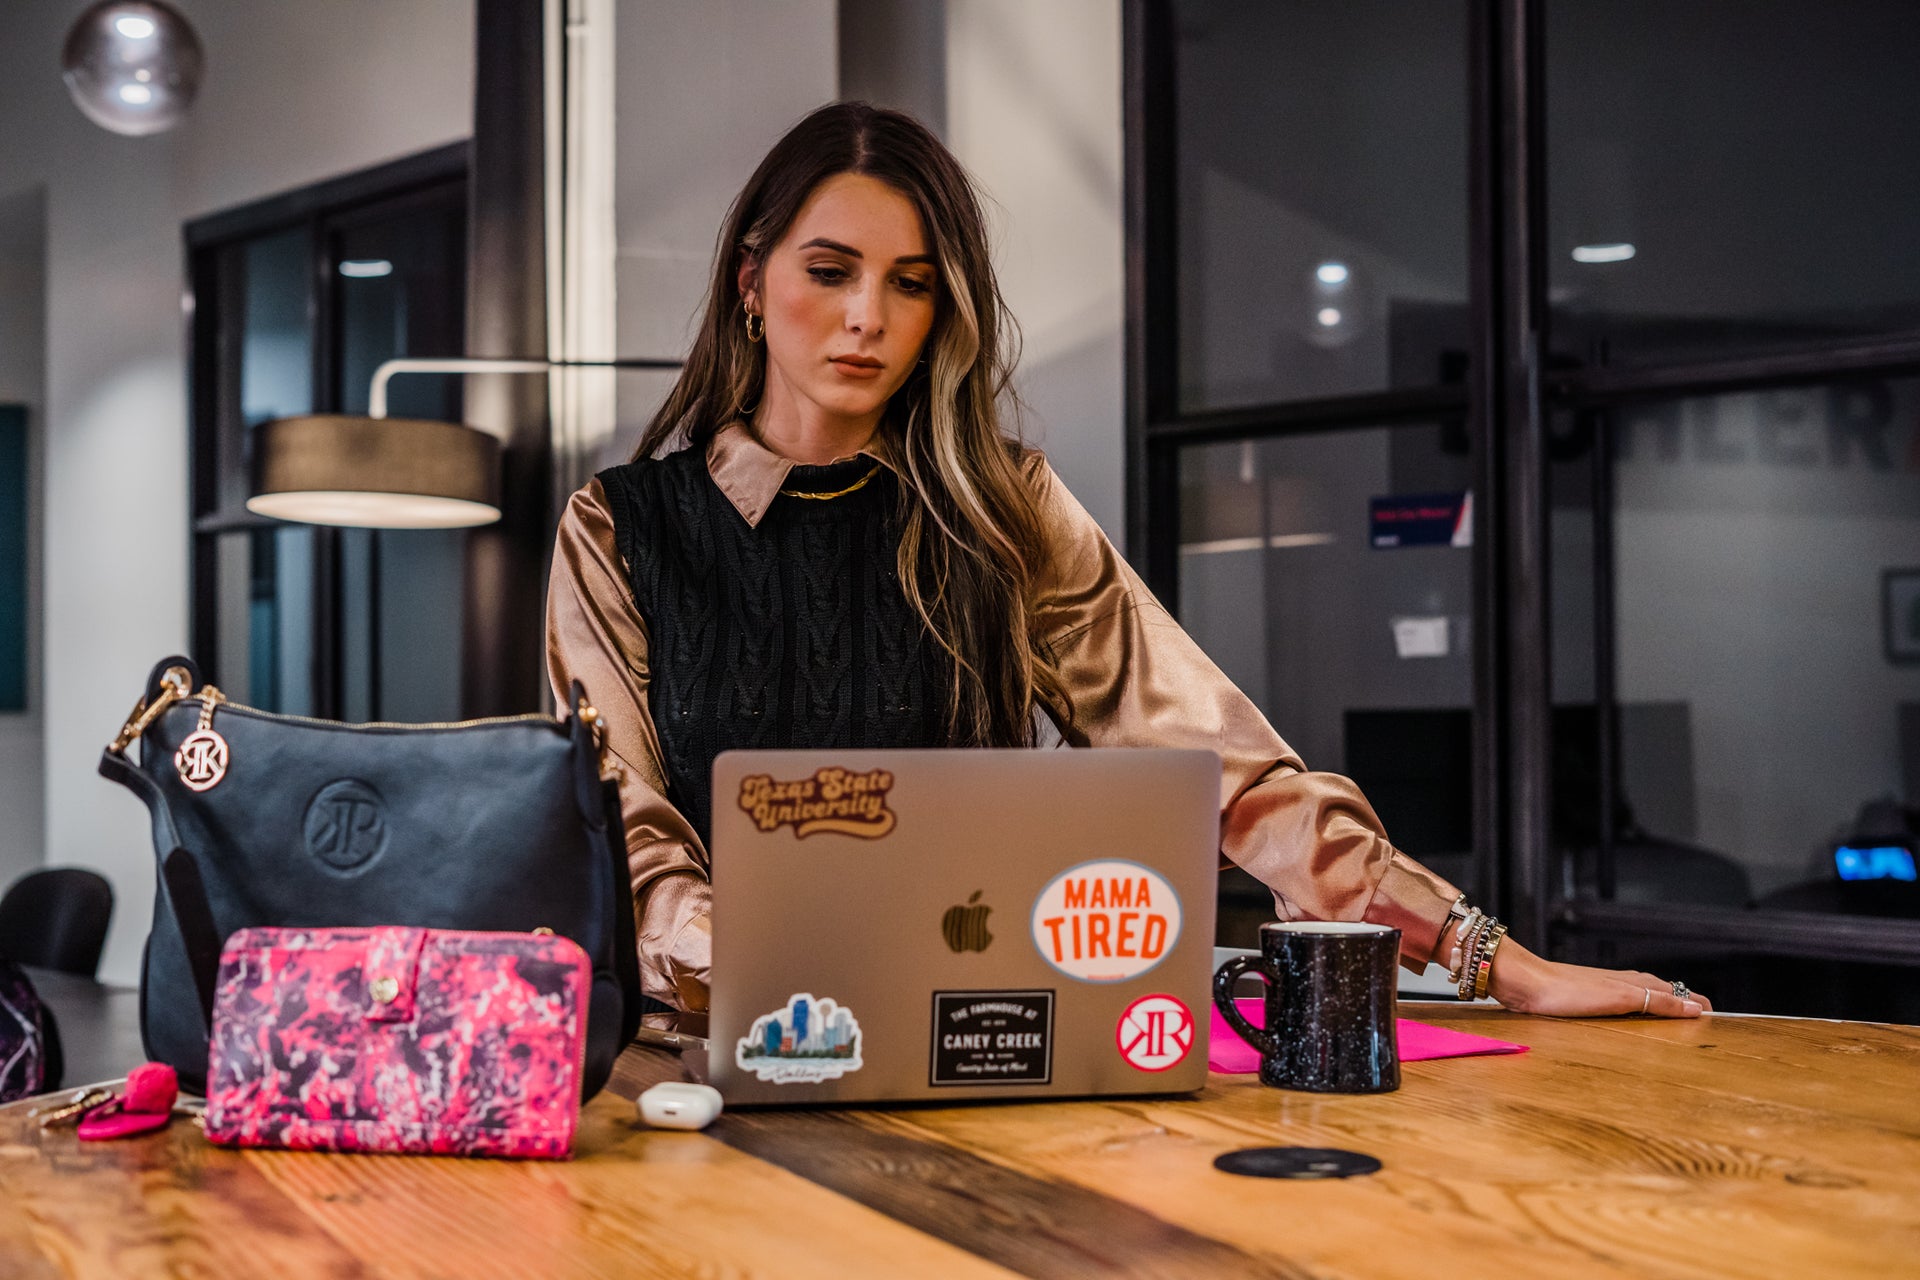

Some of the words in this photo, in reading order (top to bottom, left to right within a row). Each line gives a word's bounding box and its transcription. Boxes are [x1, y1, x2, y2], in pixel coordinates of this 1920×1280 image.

[741, 777, 815, 808] Texas
[818, 769, 891, 799] State
[754, 792, 882, 829] University
[1064, 877, 1151, 909] MAMA
[1043, 911, 1168, 963] TIRED
[950, 1007, 969, 1022] THE
[969, 1002, 1024, 1016] FARMHOUSE
[1024, 1008, 1039, 1020] AT
[943, 1033, 991, 1050] CANEY
[996, 1033, 1042, 1049] CREEK
